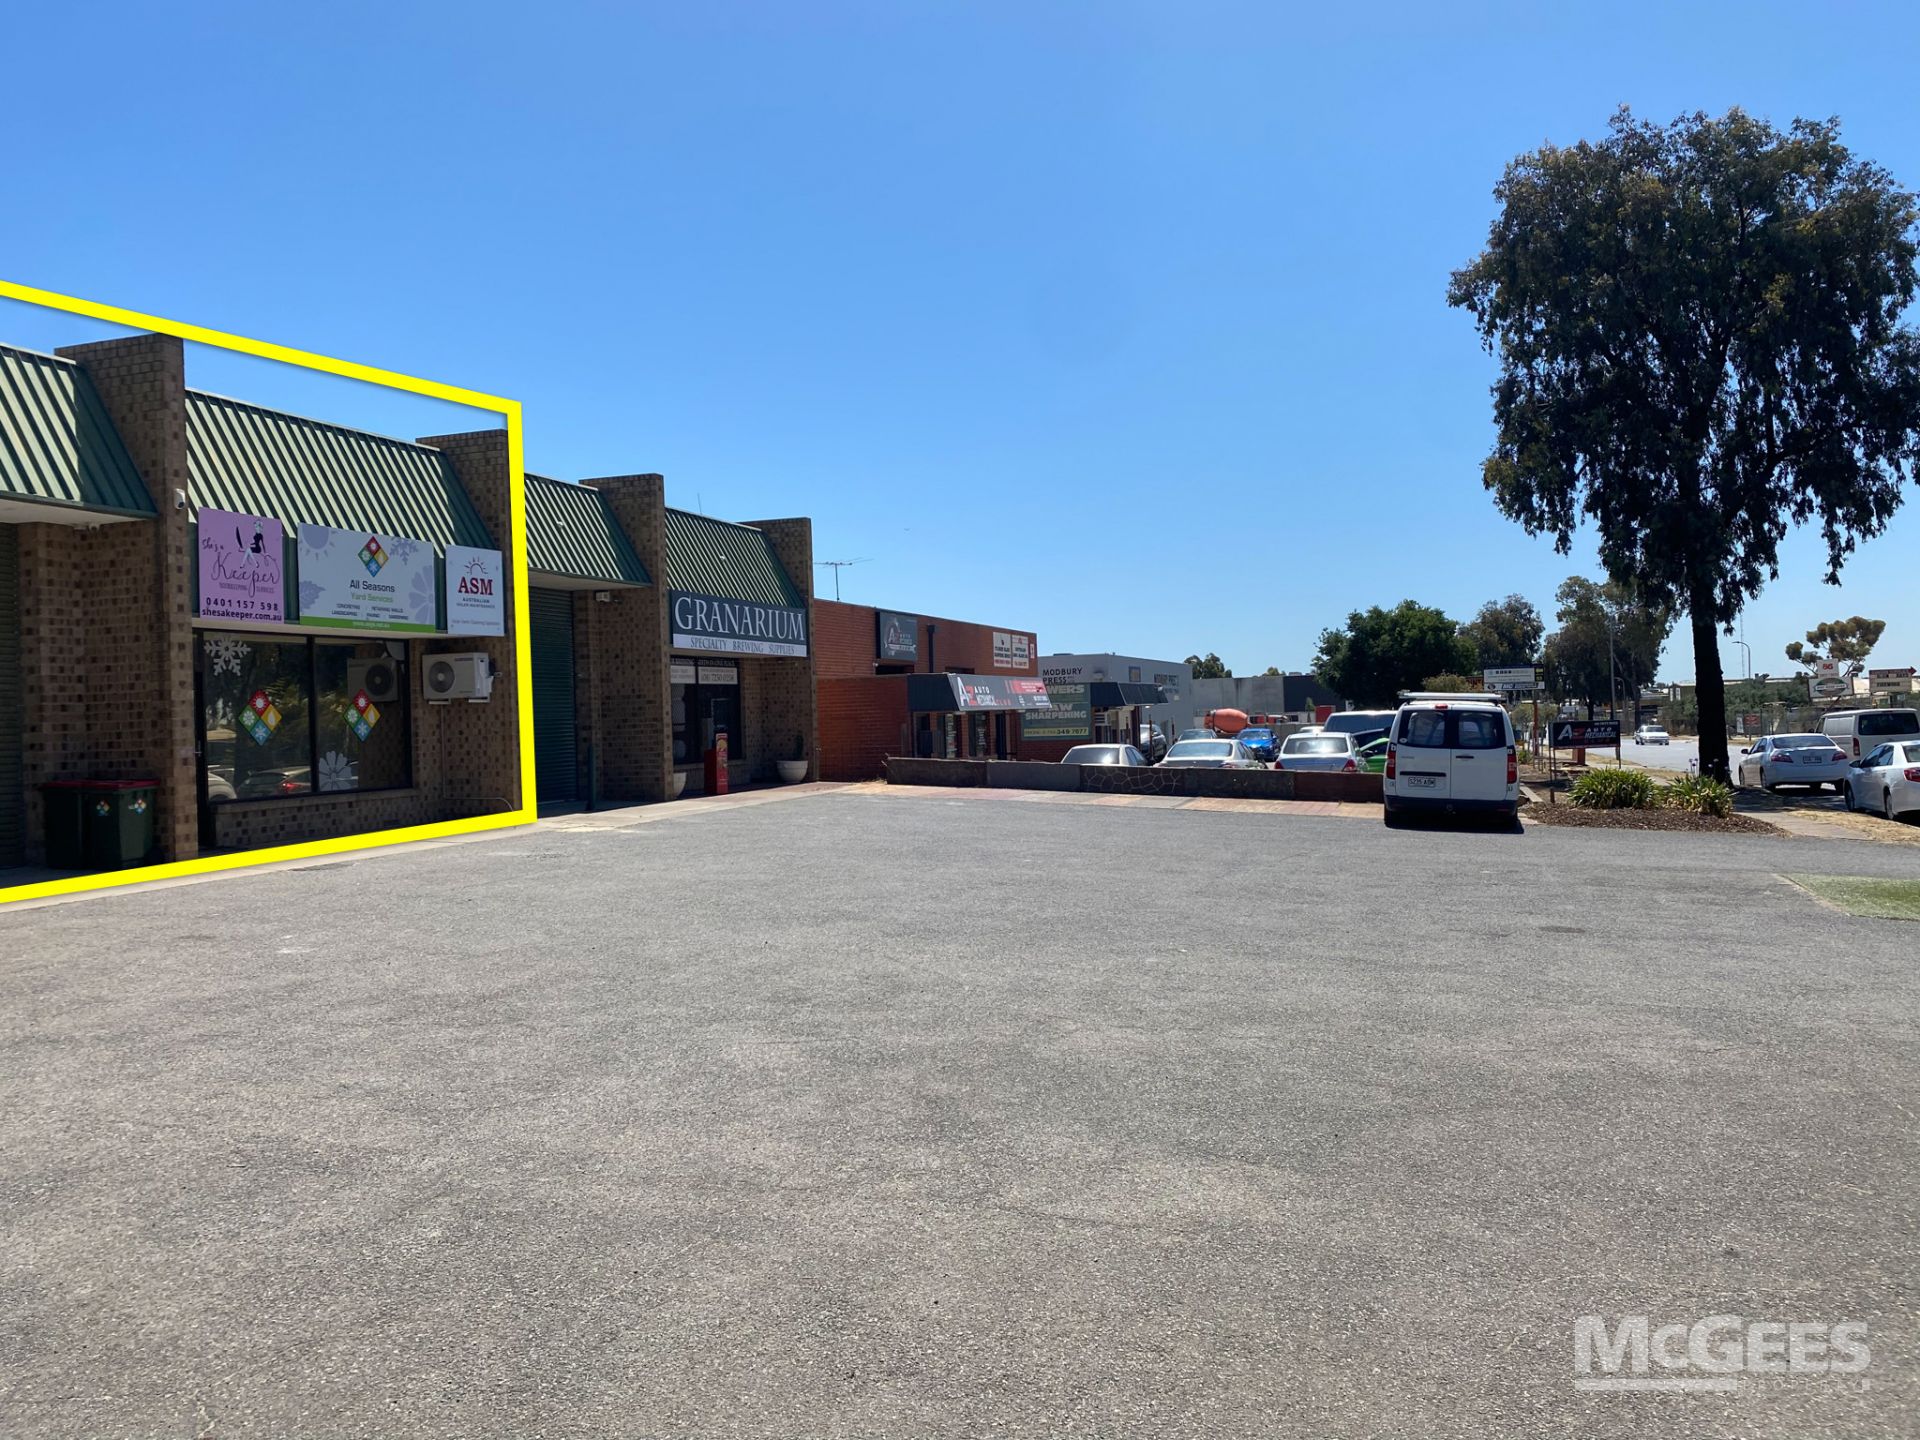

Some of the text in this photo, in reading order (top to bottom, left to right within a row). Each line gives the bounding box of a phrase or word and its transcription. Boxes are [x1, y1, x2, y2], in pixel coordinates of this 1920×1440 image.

[211, 552, 280, 598] Keeper
[350, 579, 395, 592] All Seasons
[458, 576, 494, 596] ASM
[206, 597, 278, 611] 0401 157 598
[202, 608, 282, 620] shesakeeper.com.au
[674, 595, 805, 641] GRANARIUM
[690, 637, 727, 650] SPECIALTY
[732, 641, 764, 653] BREWING
[1043, 667, 1083, 676] MODBURY
[974, 686, 990, 694] AUTO
[1025, 711, 1087, 720] SHARPENING
